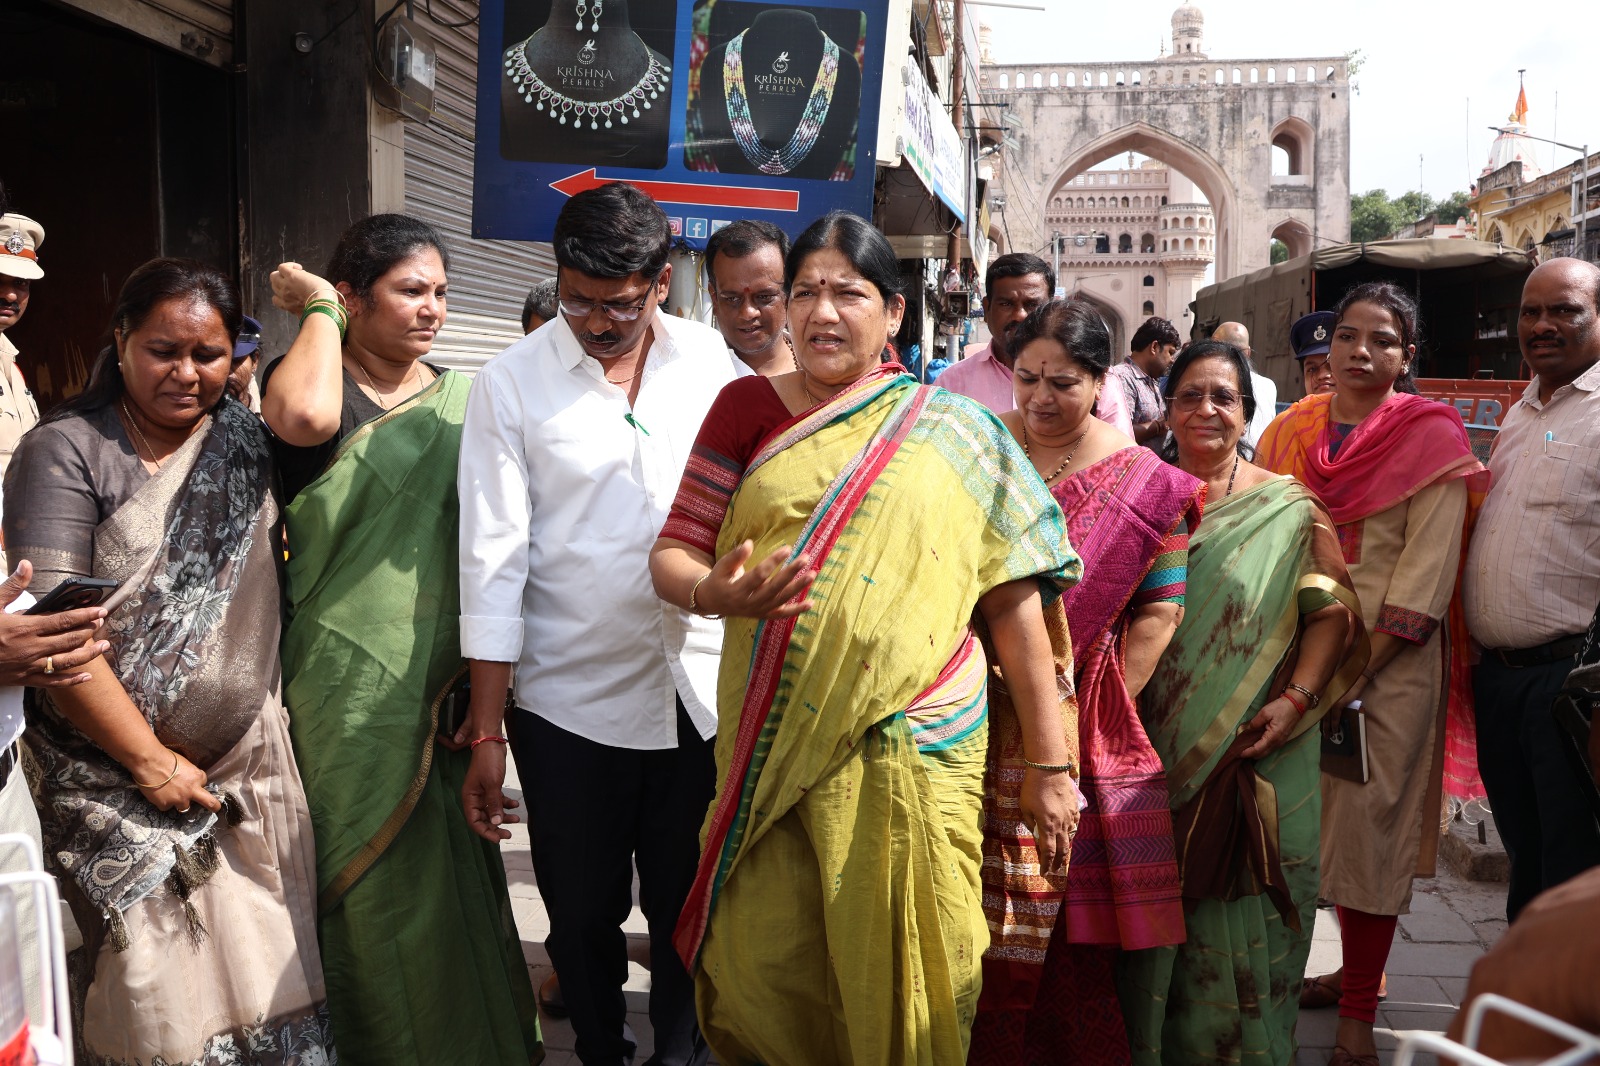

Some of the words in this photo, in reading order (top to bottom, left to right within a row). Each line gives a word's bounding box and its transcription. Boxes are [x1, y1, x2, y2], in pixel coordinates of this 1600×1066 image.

[557, 65, 616, 81] KRISHNA
[754, 73, 806, 88] KRISHNA
[562, 77, 605, 88] PEARLS
[759, 84, 797, 94] PEARLS
[1427, 397, 1503, 427] ER
